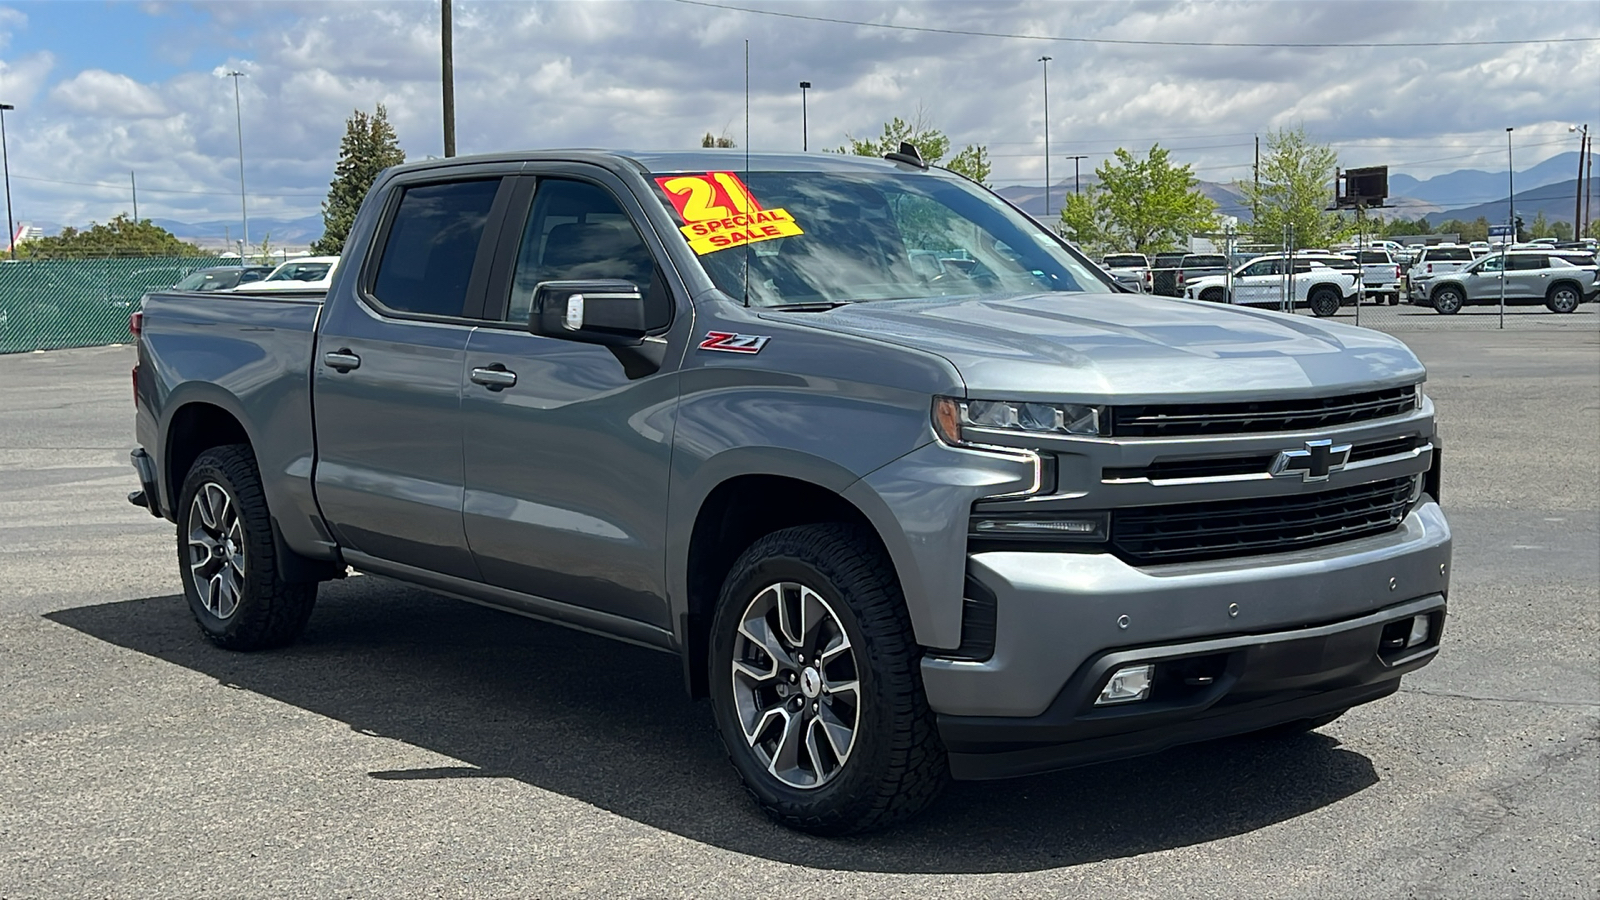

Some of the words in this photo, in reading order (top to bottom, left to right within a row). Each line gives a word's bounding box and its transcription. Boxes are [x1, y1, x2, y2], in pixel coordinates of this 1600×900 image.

[664, 172, 756, 222] 21
[692, 211, 785, 236] SPECIAL
[709, 225, 782, 247] SALE
[698, 330, 772, 354] Z71
